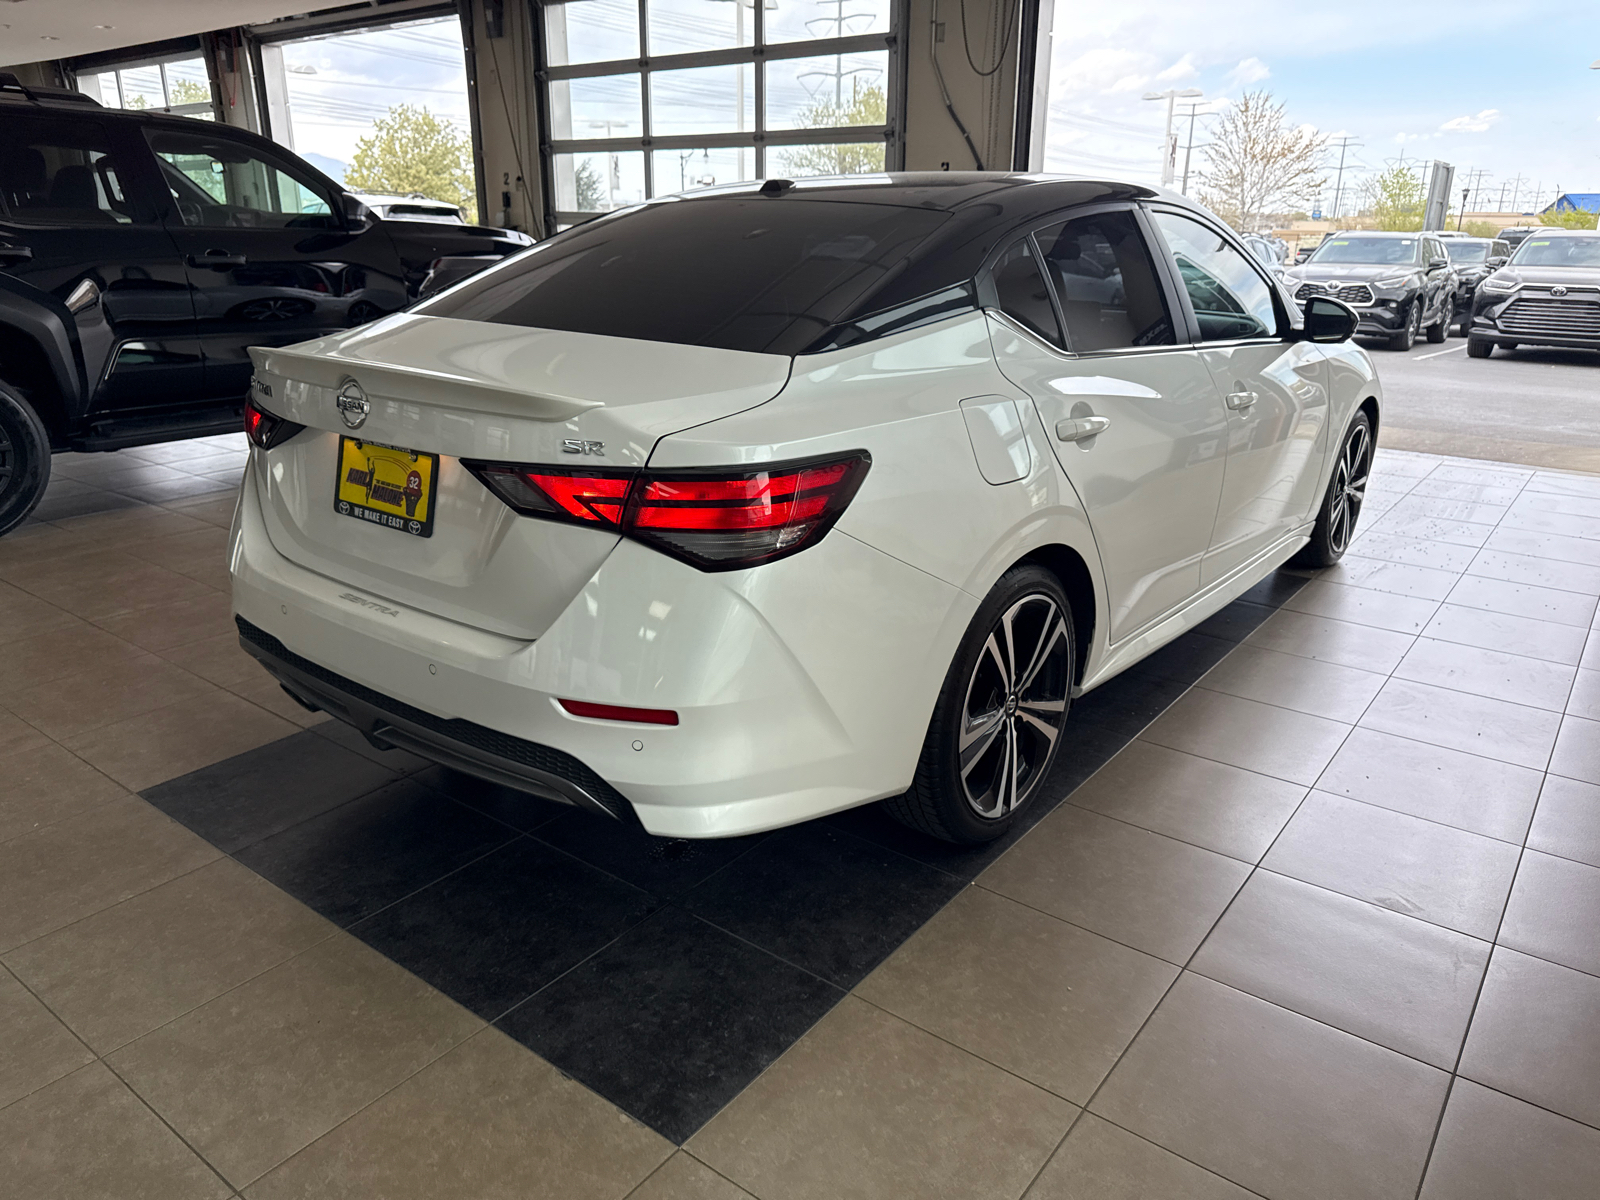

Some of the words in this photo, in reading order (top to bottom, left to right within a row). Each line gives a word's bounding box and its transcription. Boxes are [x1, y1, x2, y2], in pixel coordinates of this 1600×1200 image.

[503, 172, 510, 185] 2
[563, 439, 605, 456] SR
[409, 476, 419, 489] 32
[353, 506, 363, 517] WE
[363, 508, 380, 522] MAKE
[381, 514, 387, 525] IT
[388, 516, 404, 529] EASY
[338, 592, 400, 617] SENTRA
